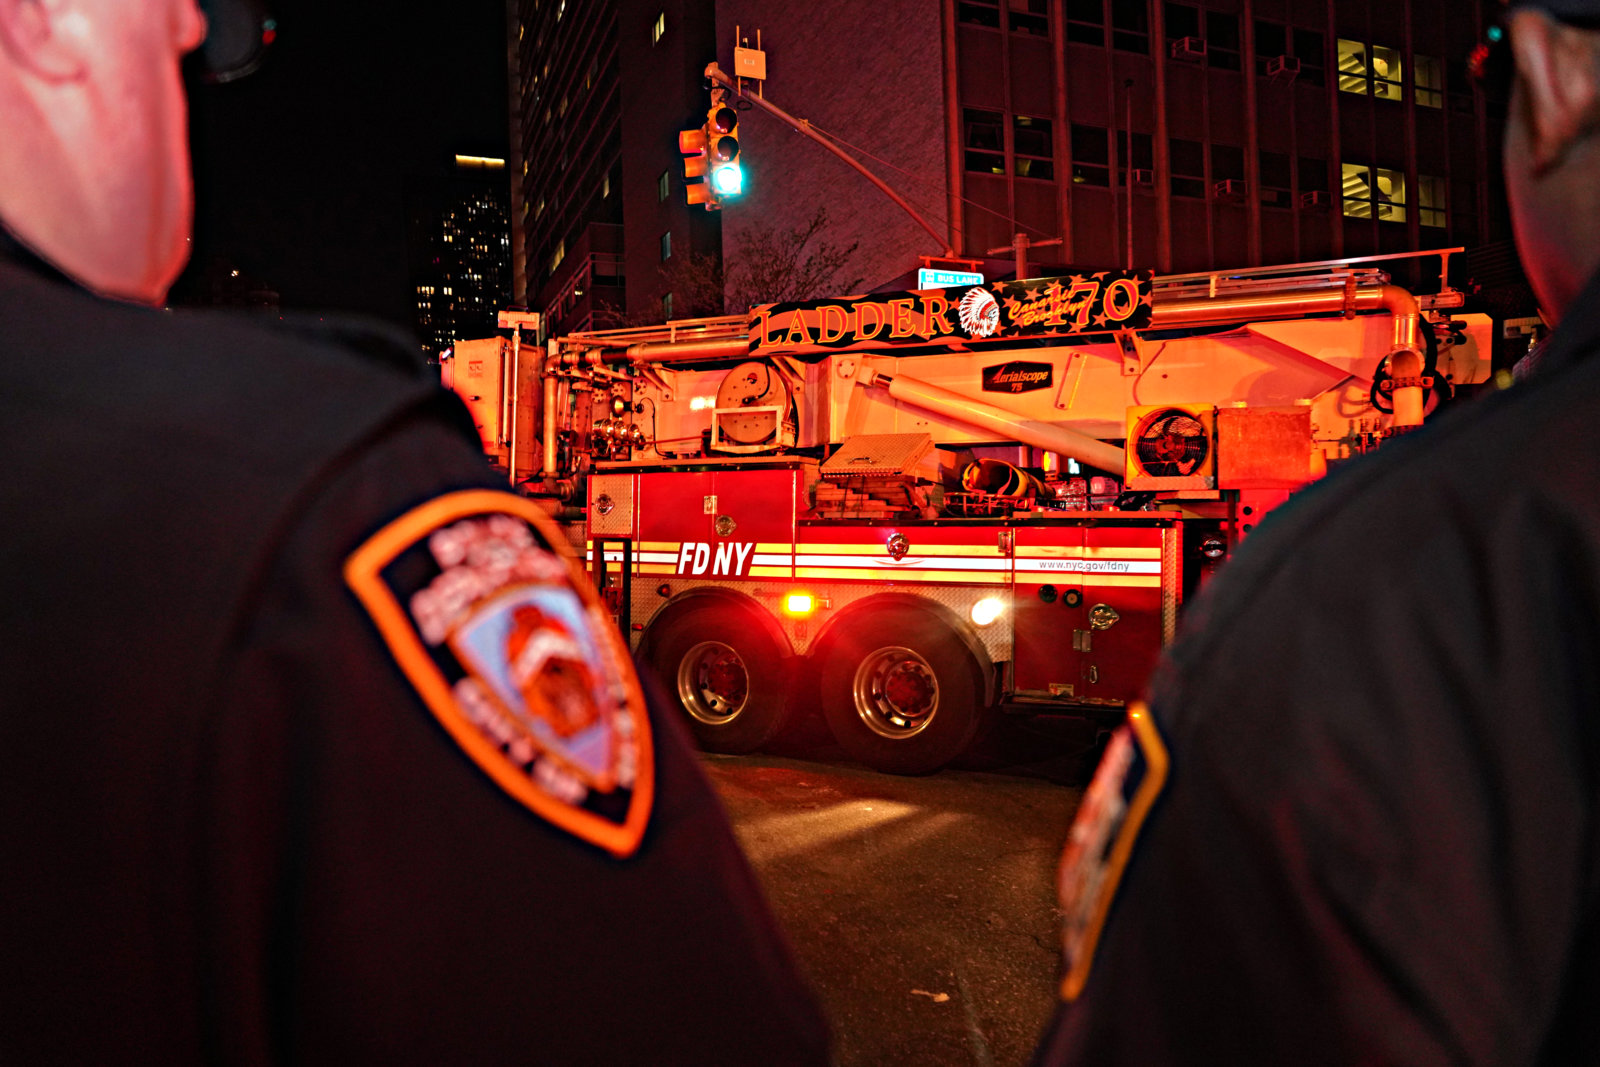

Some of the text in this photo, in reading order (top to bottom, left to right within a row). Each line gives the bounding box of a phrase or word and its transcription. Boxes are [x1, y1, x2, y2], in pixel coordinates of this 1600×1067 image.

[937, 274, 979, 285] BUS LANE
[757, 278, 1140, 348] LADDER 170
[1007, 288, 1077, 320] Canarsie
[1022, 299, 1088, 326] Brooklyn
[1011, 382, 1023, 392] 75
[1039, 561, 1130, 572] www.nyc.gov/fdny
